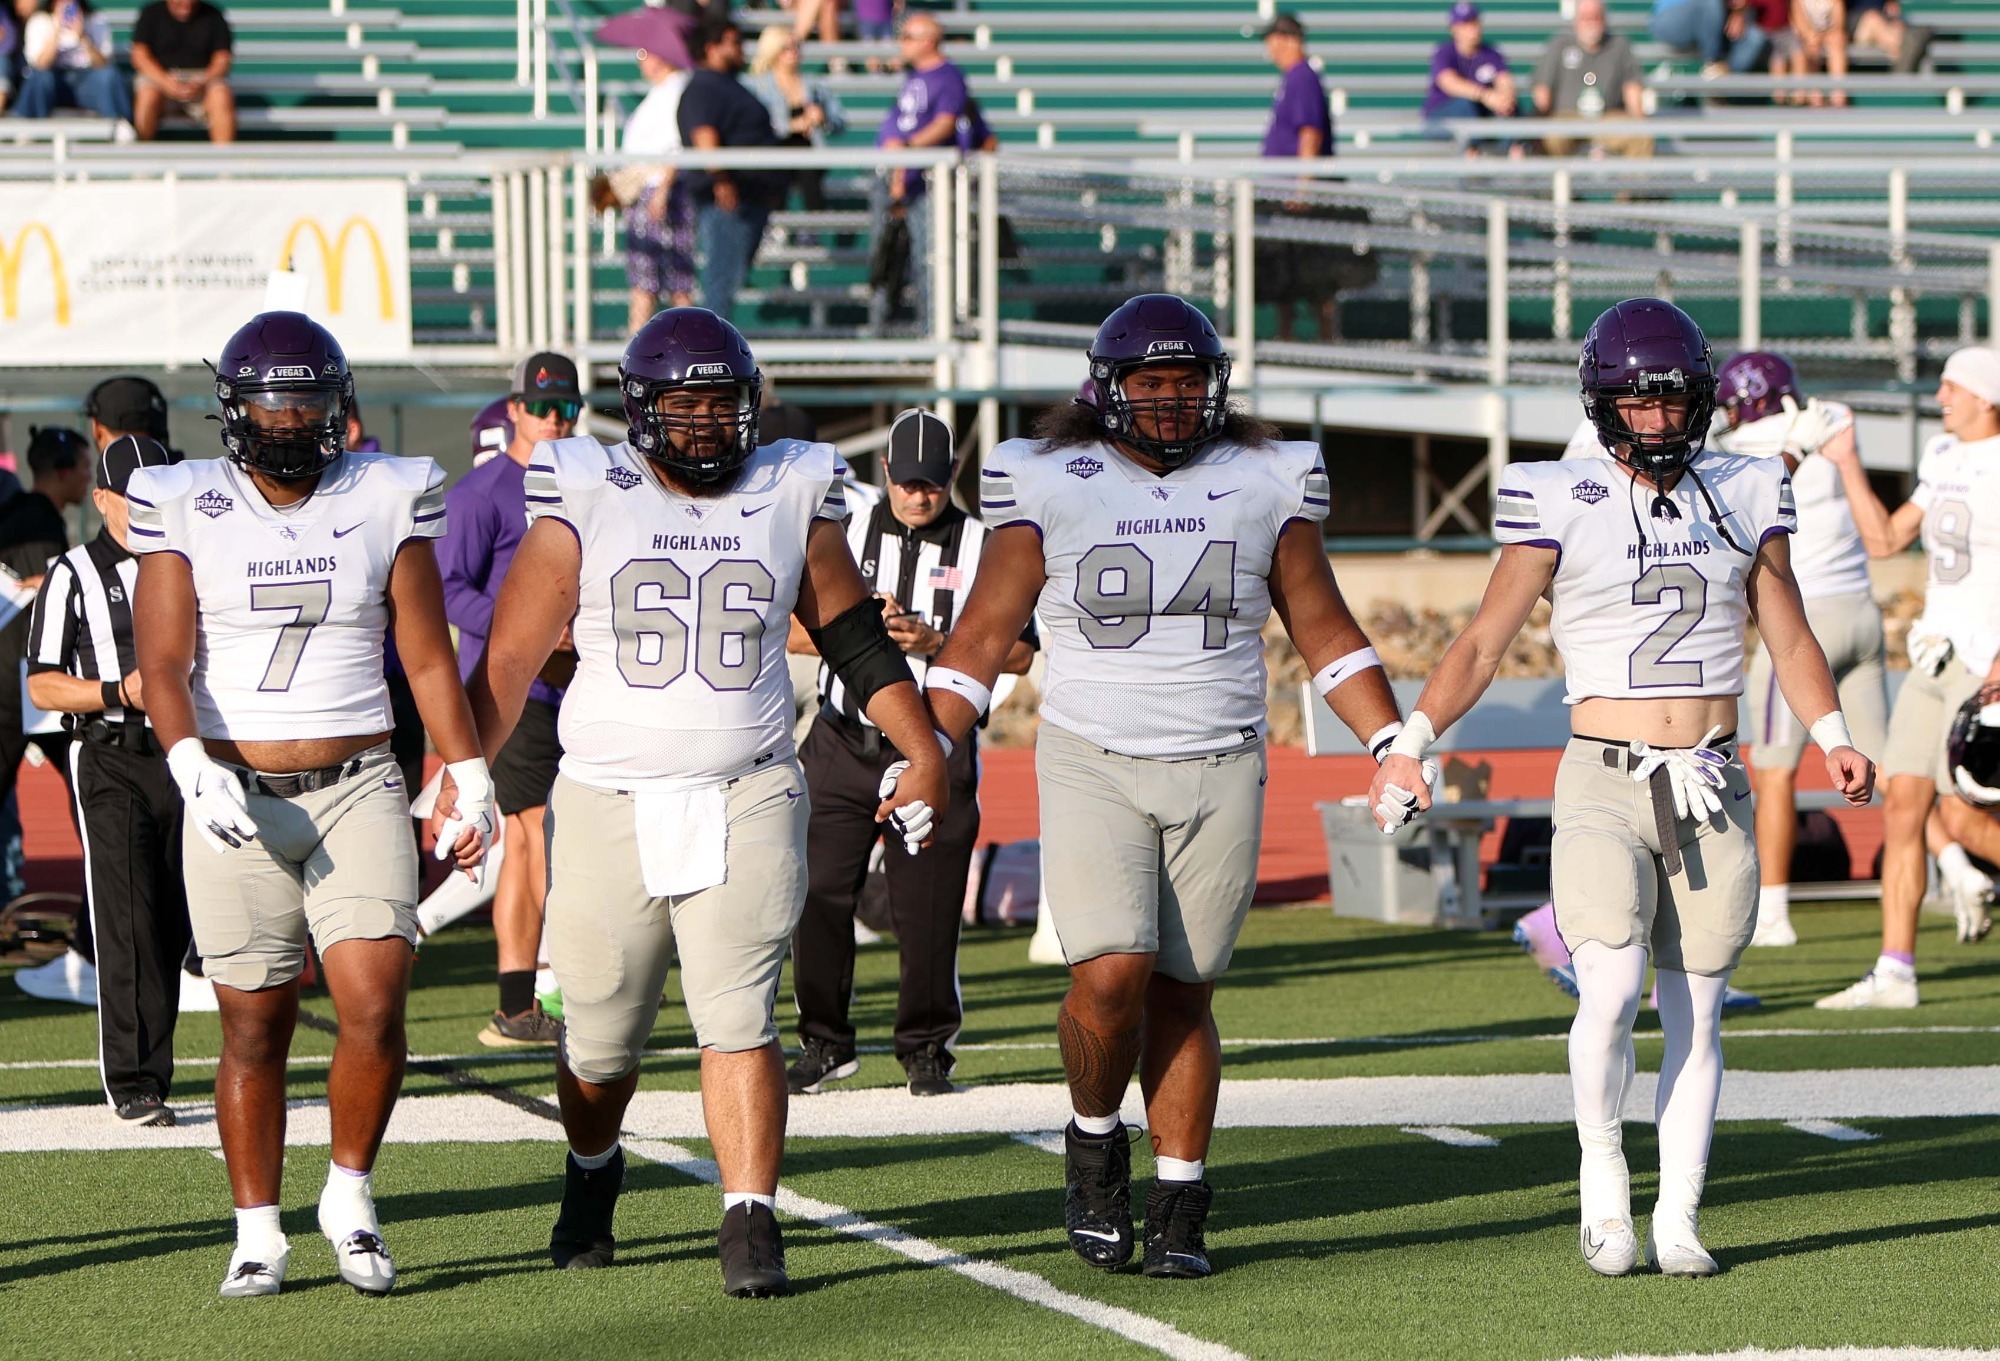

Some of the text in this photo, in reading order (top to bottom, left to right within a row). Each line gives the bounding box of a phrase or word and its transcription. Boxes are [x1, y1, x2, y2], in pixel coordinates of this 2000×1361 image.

[1157, 342, 1184, 351] VEGAS
[276, 368, 305, 377] VEGAS
[697, 365, 724, 375] VEGAS
[1647, 371, 1673, 382] VEGAS
[1066, 462, 1104, 473] RMAC
[606, 470, 642, 484] RMAC
[1571, 486, 1609, 499] RMAC
[195, 498, 233, 511] RMAC
[1115, 517, 1206, 536] HIGHLANDS
[652, 534, 741, 551] HIGHLANDS
[1627, 540, 1711, 559] HGHLANDS
[247, 556, 337, 578] HIGHLANDS
[861, 559, 876, 578] S
[109, 585, 123, 603] S
[1073, 540, 1239, 650] 94
[610, 558, 776, 692] 66
[1628, 562, 1709, 690] 2
[249, 579, 333, 693] 7
